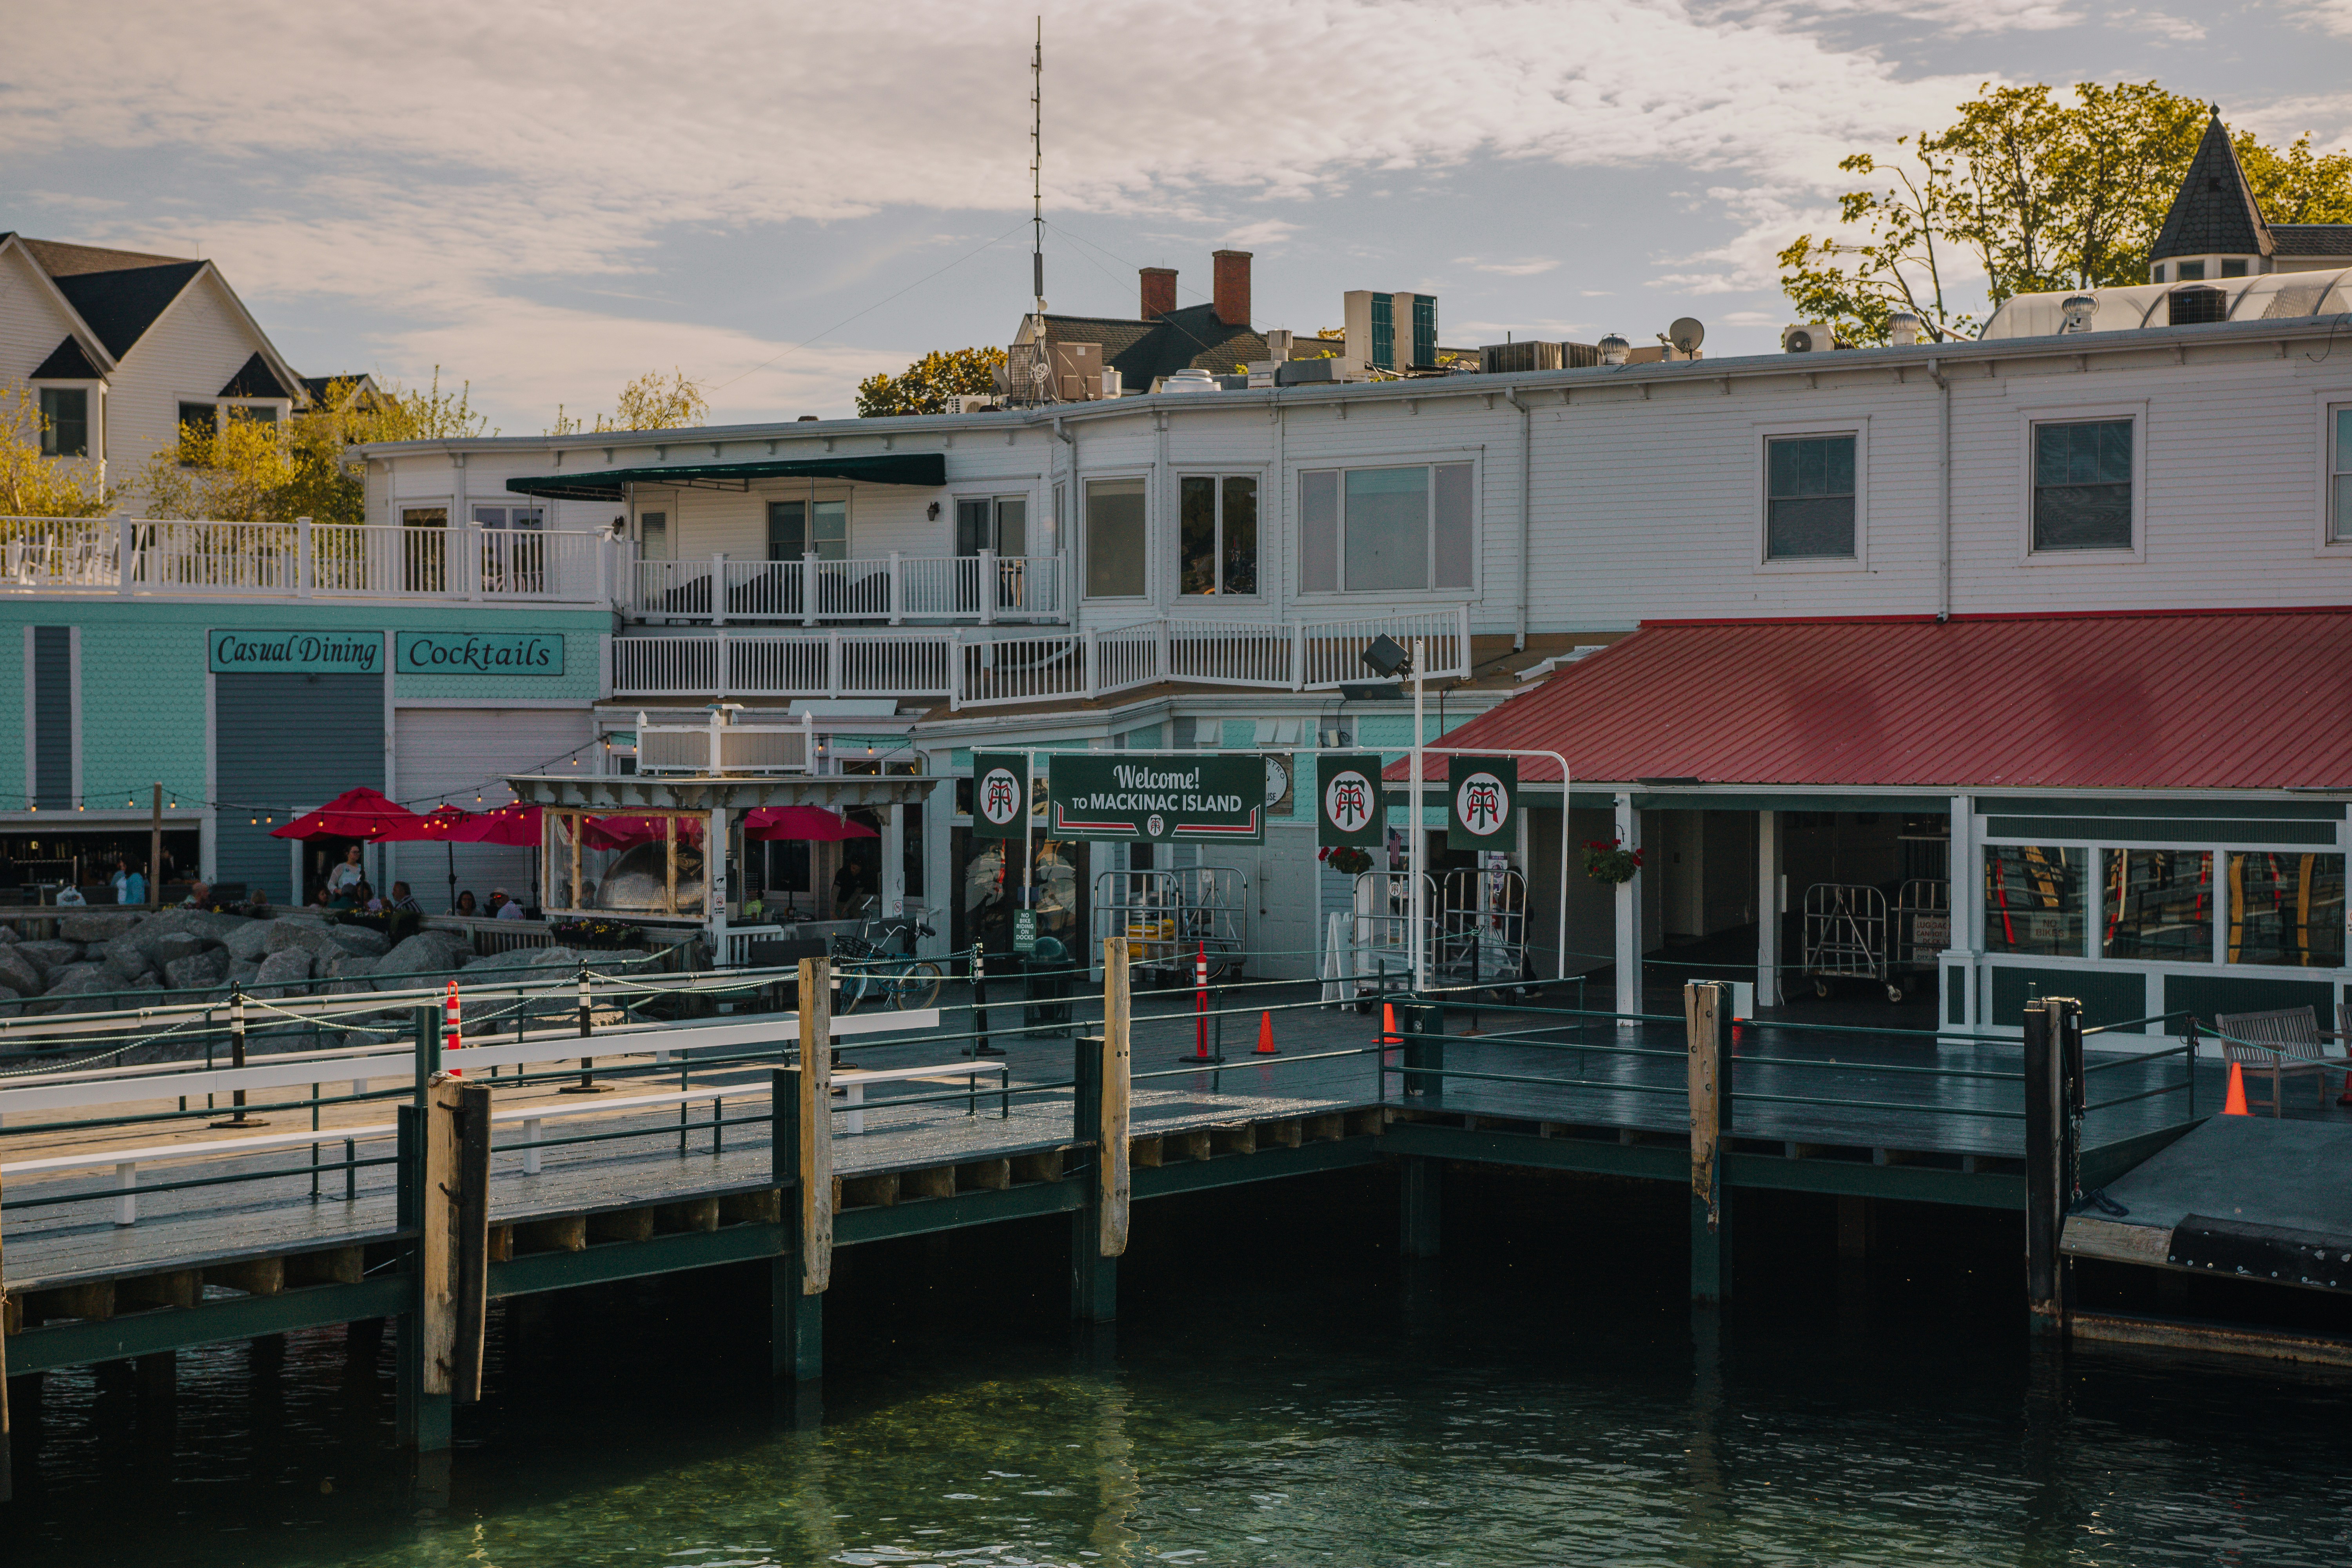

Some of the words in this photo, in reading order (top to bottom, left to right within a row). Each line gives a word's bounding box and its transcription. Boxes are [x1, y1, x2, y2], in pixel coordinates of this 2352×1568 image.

[218, 635, 298, 664] Casual
[299, 637, 377, 670] Dining
[410, 637, 550, 671] Cocktails
[1113, 765, 1200, 789] Welcome!
[1267, 759, 1285, 779] STRO
[1072, 797, 1088, 809] TO
[1091, 793, 1178, 811] MACKINAC
[1182, 795, 1242, 812] ISLAND
[2036, 928, 2064, 937] BIKES
[2043, 919, 2057, 927] NO
